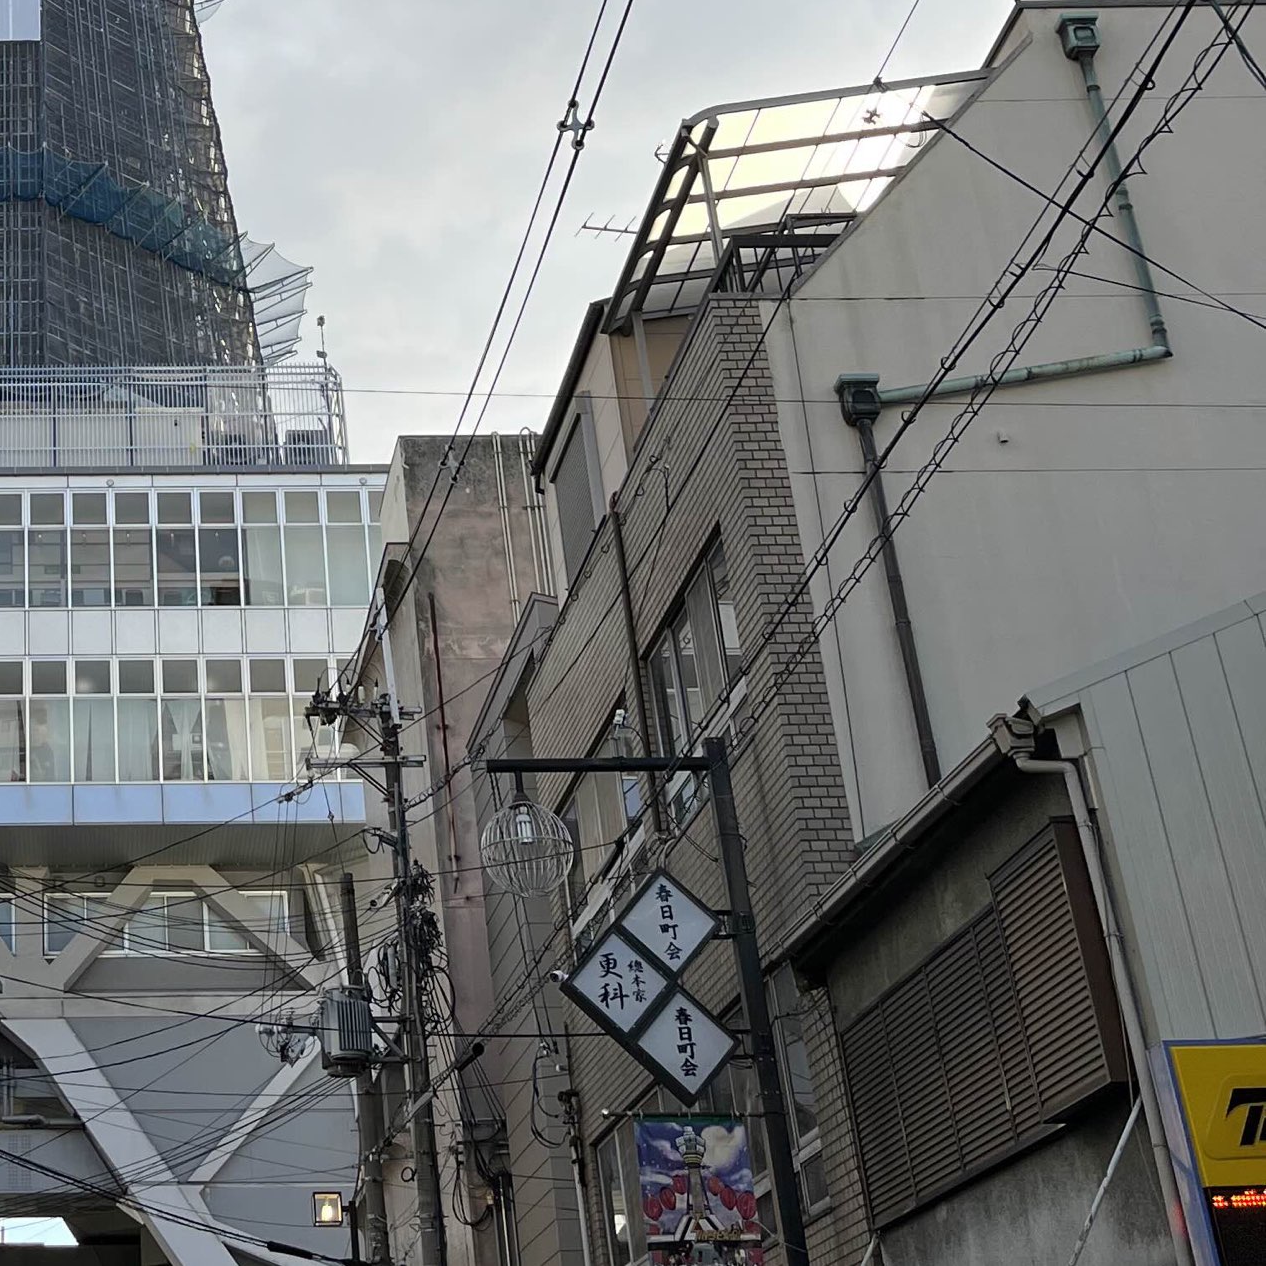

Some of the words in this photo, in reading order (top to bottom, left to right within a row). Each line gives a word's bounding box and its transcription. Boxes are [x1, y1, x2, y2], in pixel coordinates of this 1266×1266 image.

[655, 884, 683, 960] 春日町会
[598, 952, 629, 1010] 更科
[675, 1006, 699, 1077] 春日町会
